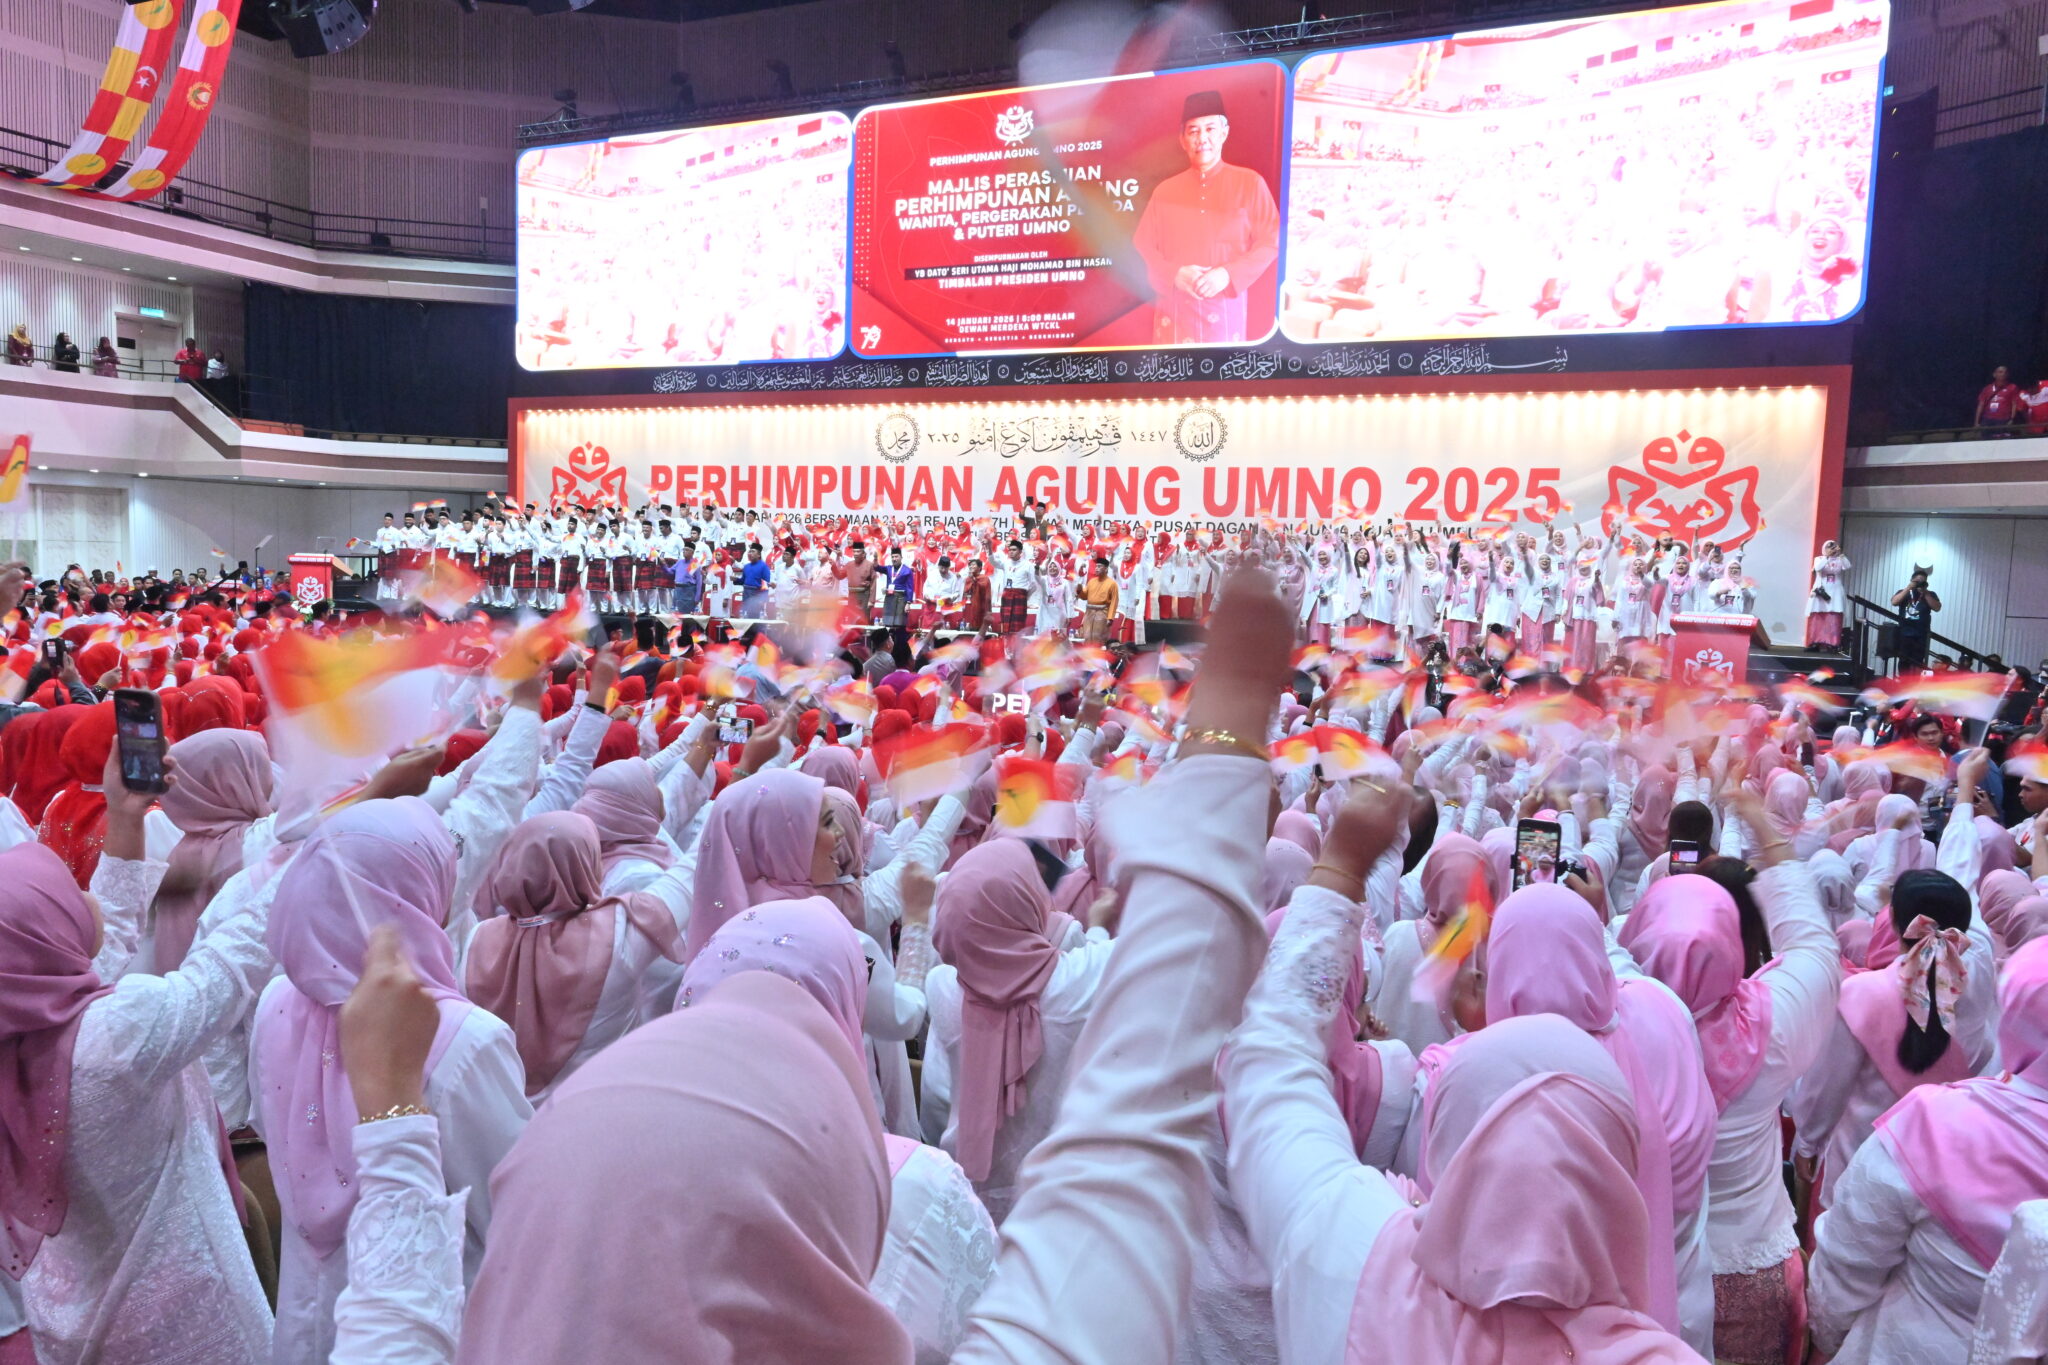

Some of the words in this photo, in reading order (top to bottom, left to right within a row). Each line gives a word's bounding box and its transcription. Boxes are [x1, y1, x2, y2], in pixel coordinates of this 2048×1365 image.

[929, 151, 1002, 167] PERHIMPUNAN
[1078, 140, 1103, 151] 2025
[928, 175, 991, 195] MAJLIS
[995, 165, 1102, 189] PERASIAN
[895, 186, 1050, 216] PERHIMPUNAN
[1055, 179, 1139, 203] ANG
[898, 212, 958, 230] WANITA,
[962, 205, 1062, 226] PERGERAKAN
[953, 229, 965, 241] &
[967, 223, 1019, 240] PUTERI
[1023, 219, 1071, 235] UMNO
[1031, 250, 1048, 259] OLEH
[915, 269, 926, 278] YB
[952, 267, 969, 276] SERI
[971, 265, 998, 275] UTAMA
[1001, 264, 1018, 274] HAJI
[1020, 260, 1064, 271] MOHAMAD
[1066, 259, 1080, 268] BIN
[1083, 257, 1112, 267] HASAN
[938, 278, 993, 289] TIMBALAN
[995, 273, 1049, 286] PRESIDEN
[1052, 270, 1086, 282] UMNO
[959, 325, 988, 334] DEWAN
[990, 322, 1030, 332] MERDEKA
[650, 465, 974, 513] PERHIMPUNAN
[989, 465, 1181, 515] AGUNG
[1201, 466, 1382, 520] UMNO
[1405, 467, 1561, 524] 2025
